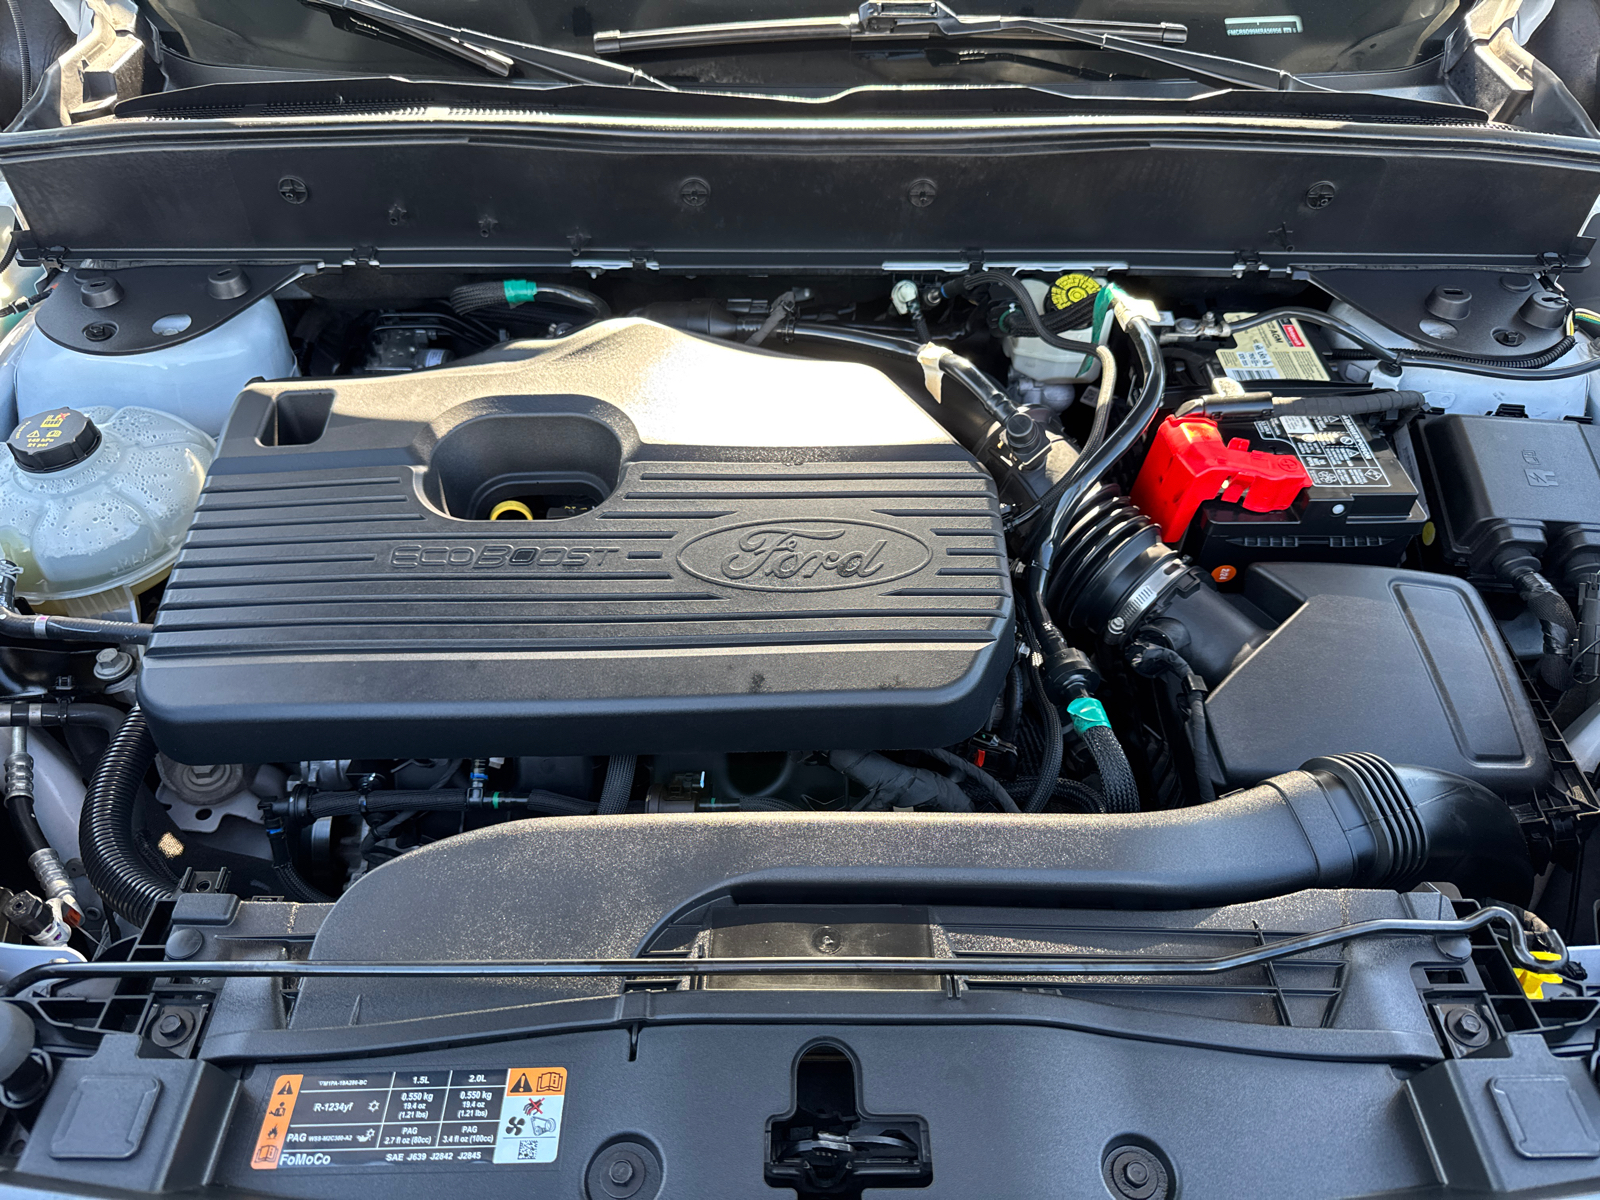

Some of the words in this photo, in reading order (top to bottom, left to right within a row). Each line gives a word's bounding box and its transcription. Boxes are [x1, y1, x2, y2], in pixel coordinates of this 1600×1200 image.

[1270, 328, 1284, 344] AGM
[721, 527, 888, 579] Ford
[468, 1074, 486, 1083] 2.0L
[401, 1092, 421, 1101] 0.550
[422, 1092, 433, 1102] kg
[460, 1091, 480, 1100] 0.550
[481, 1091, 492, 1100] kg
[314, 1102, 353, 1113] R-1234yf
[399, 1112, 412, 1120] (1.21
[414, 1111, 428, 1119] lbs)
[458, 1110, 471, 1118] (1.21
[473, 1109, 488, 1118] lbs)
[287, 1133, 306, 1143] PAG
[411, 1135, 431, 1145] (80cc)
[469, 1134, 494, 1143] (100cc)
[279, 1154, 331, 1166] FoMoCo
[407, 1152, 426, 1160] J639
[430, 1152, 453, 1160] J2842
[458, 1151, 481, 1159] J2845
